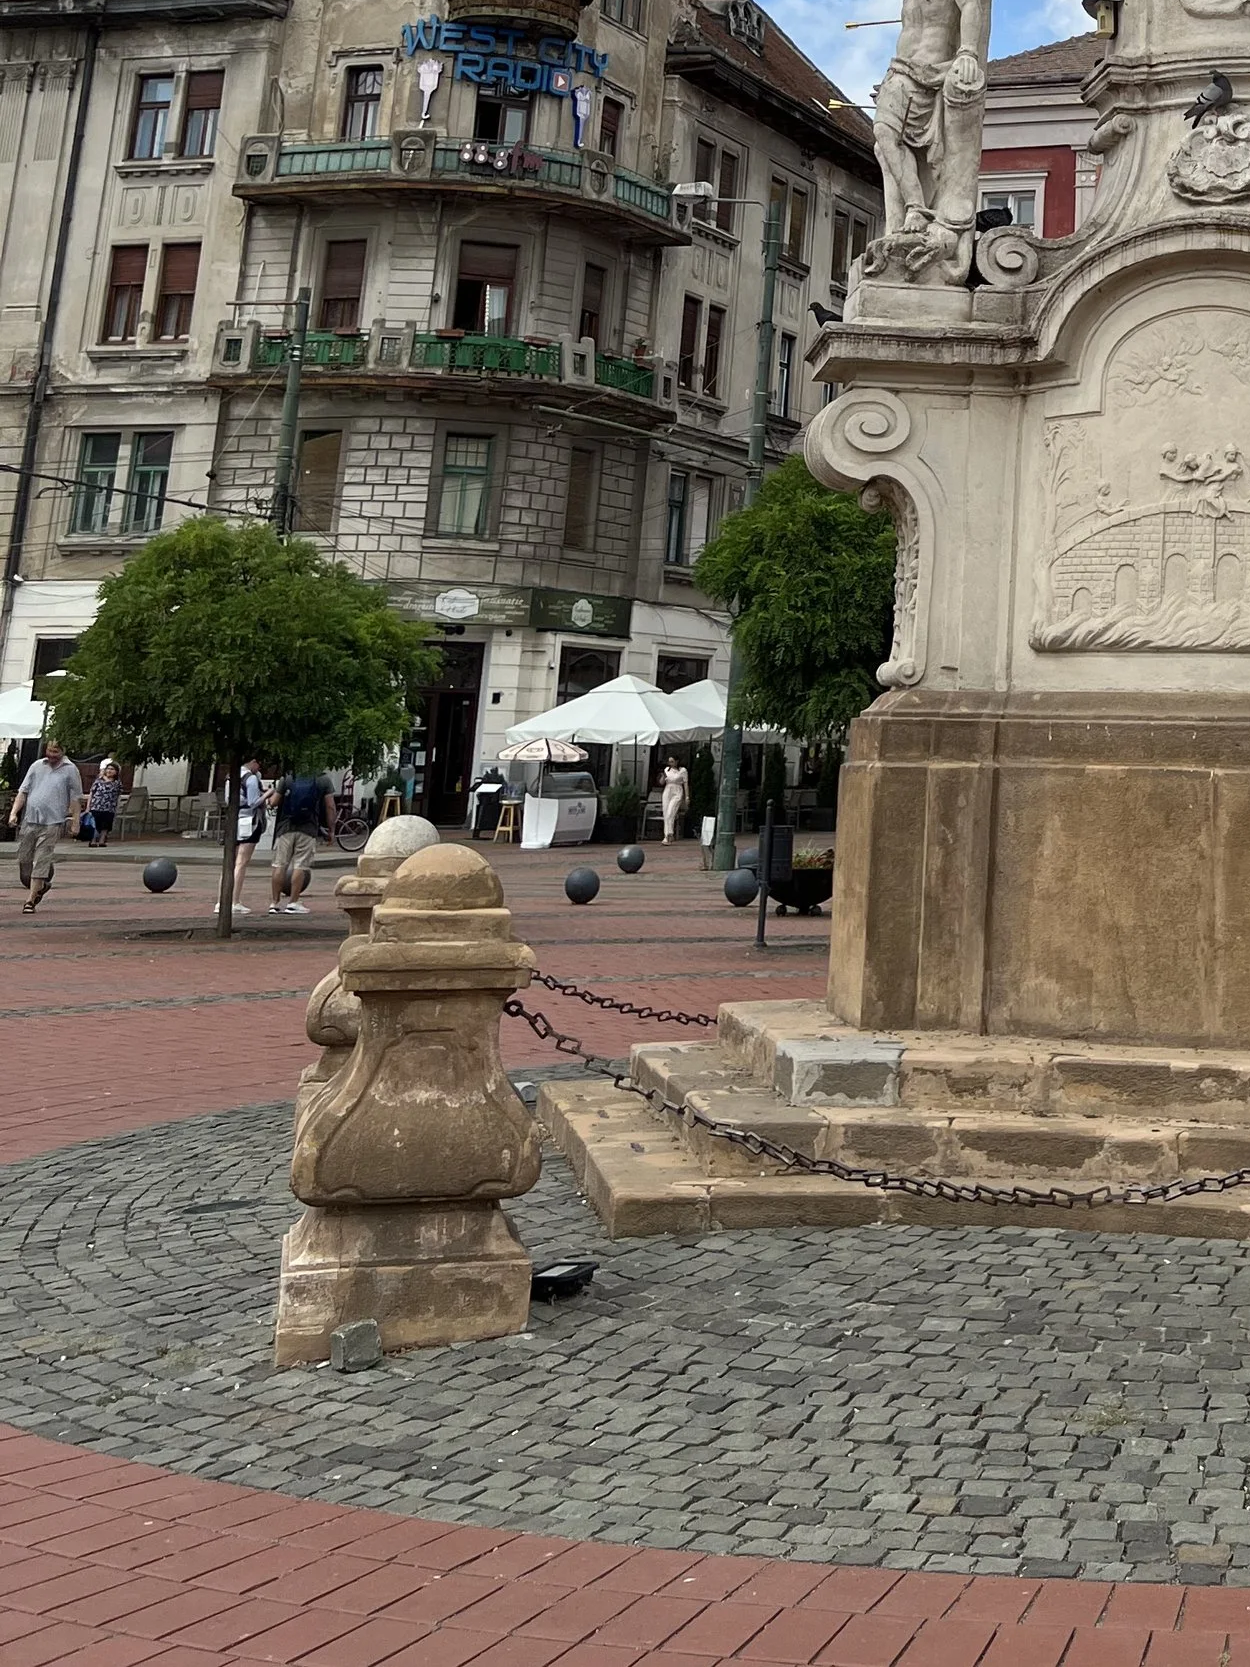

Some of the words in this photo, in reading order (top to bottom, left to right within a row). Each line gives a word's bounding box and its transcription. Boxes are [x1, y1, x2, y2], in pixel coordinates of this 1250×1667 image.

[402, 14, 525, 56] WEST
[539, 36, 608, 77] CITY
[455, 52, 573, 97] RADIO
